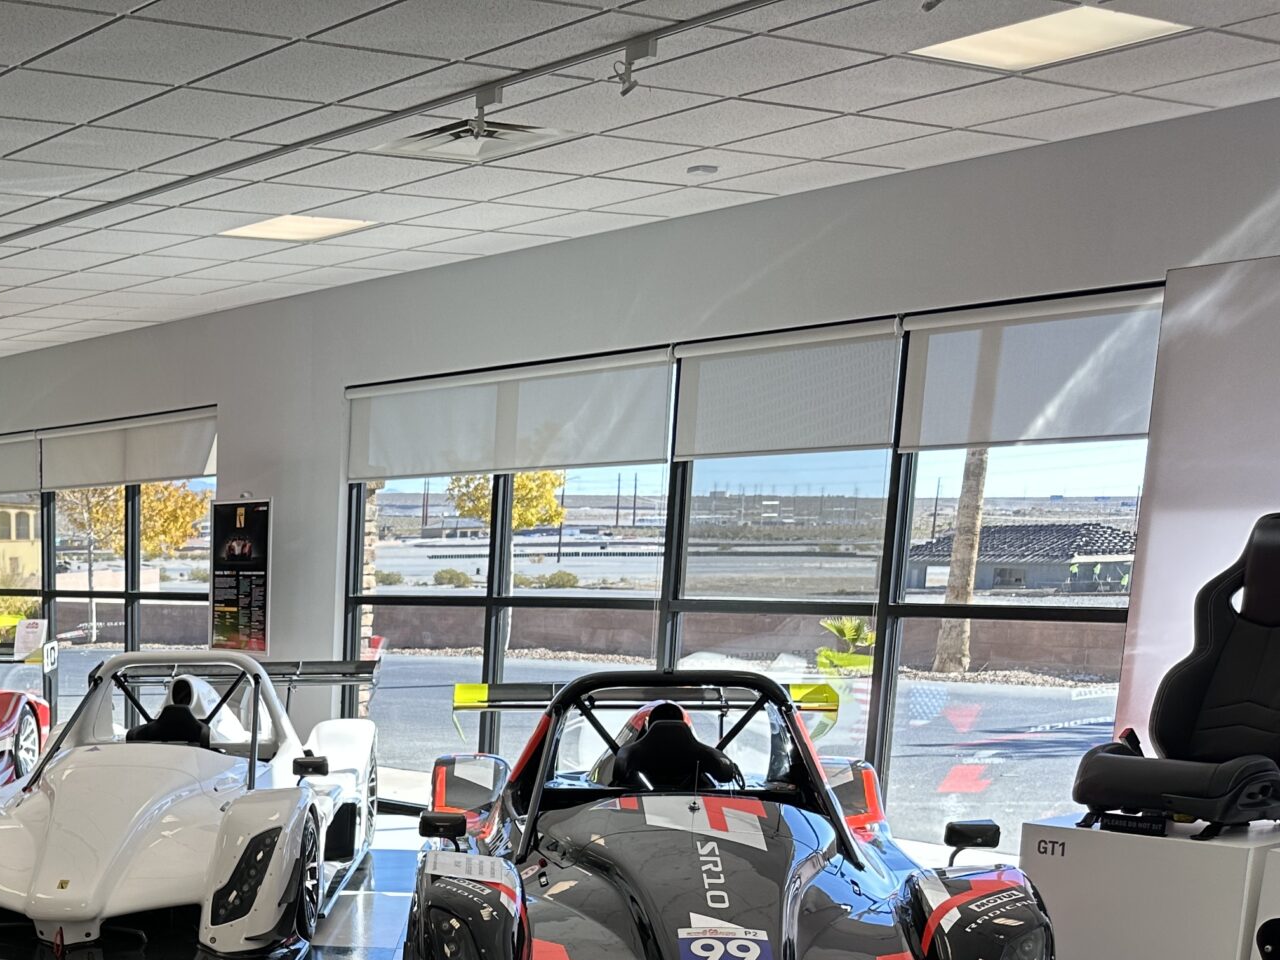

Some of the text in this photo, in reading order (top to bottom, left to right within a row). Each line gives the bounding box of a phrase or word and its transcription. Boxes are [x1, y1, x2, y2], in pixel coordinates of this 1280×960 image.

[1037, 839, 1066, 857] GT1
[696, 841, 730, 908] SR10
[435, 883, 500, 920] RADICAL
[965, 899, 1039, 932] RADICAL
[974, 892, 1020, 910] MOTUL
